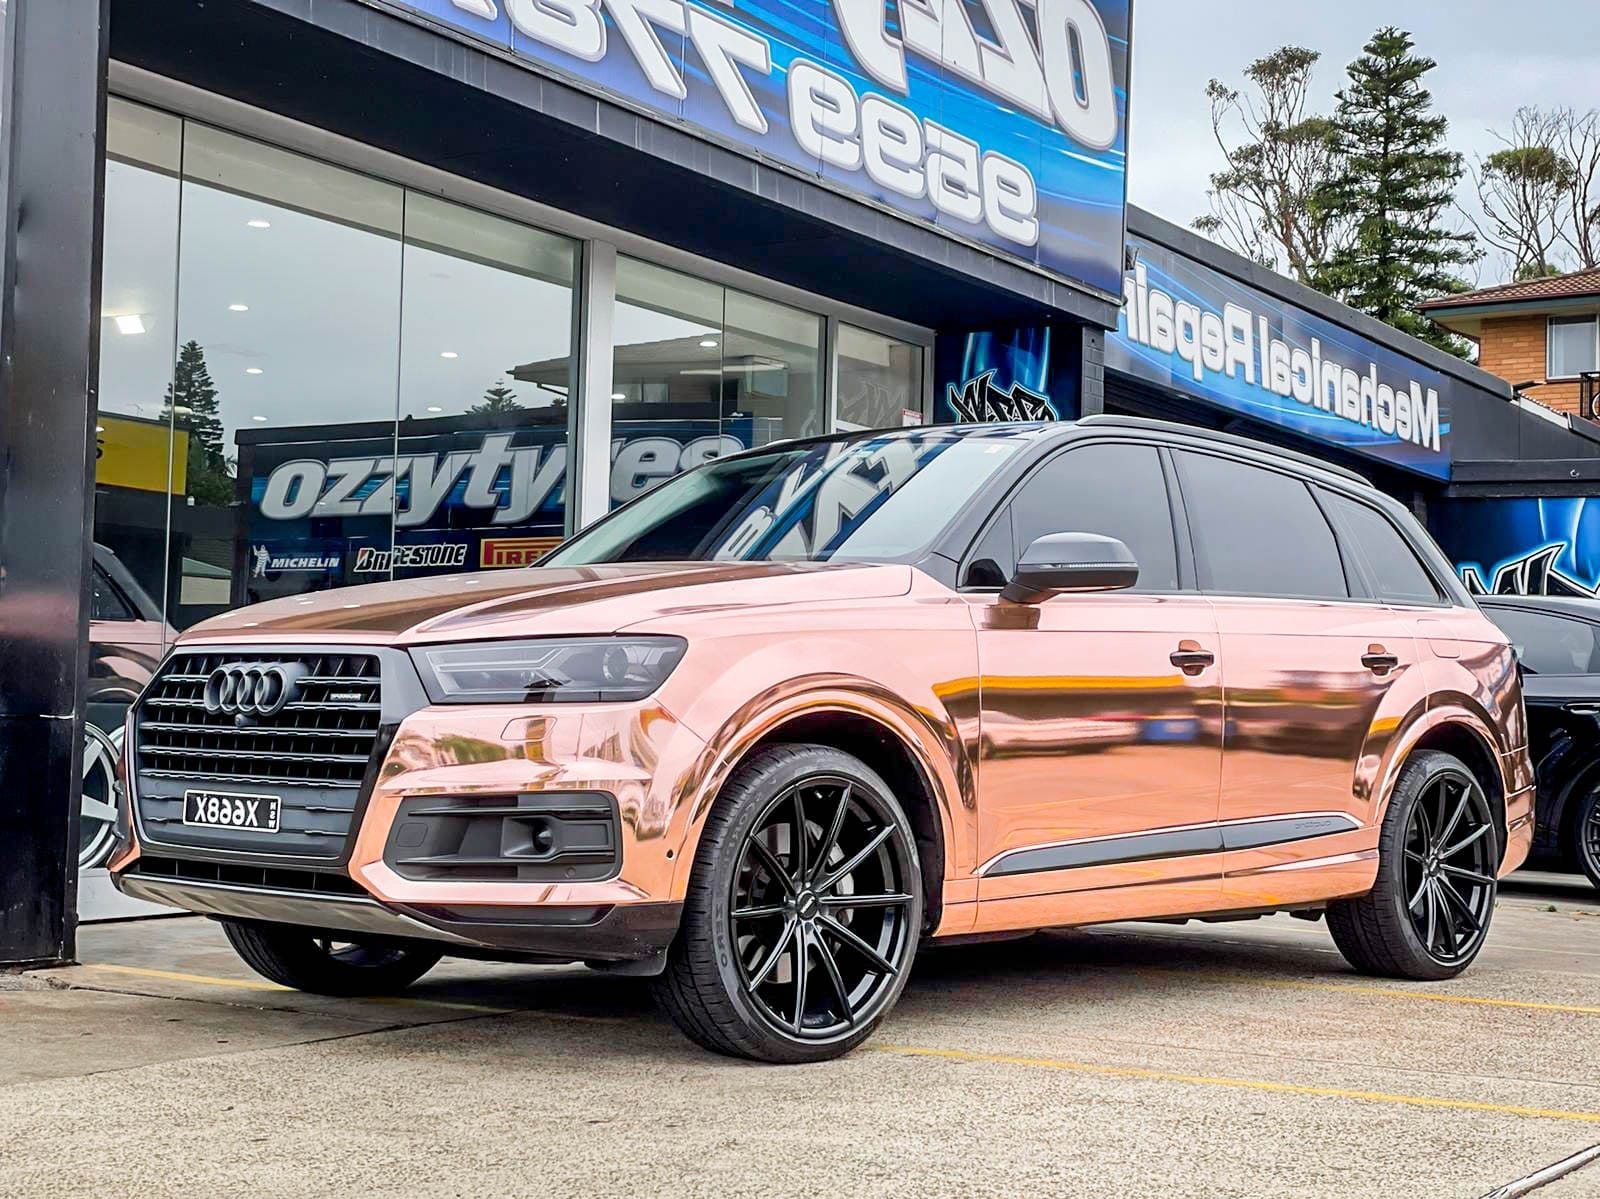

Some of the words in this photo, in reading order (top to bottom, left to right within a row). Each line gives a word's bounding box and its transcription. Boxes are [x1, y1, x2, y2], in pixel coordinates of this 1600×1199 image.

[260, 432, 745, 526] ozzytyes
[271, 557, 340, 568] MICHELIN
[484, 540, 562, 565] PIRE
